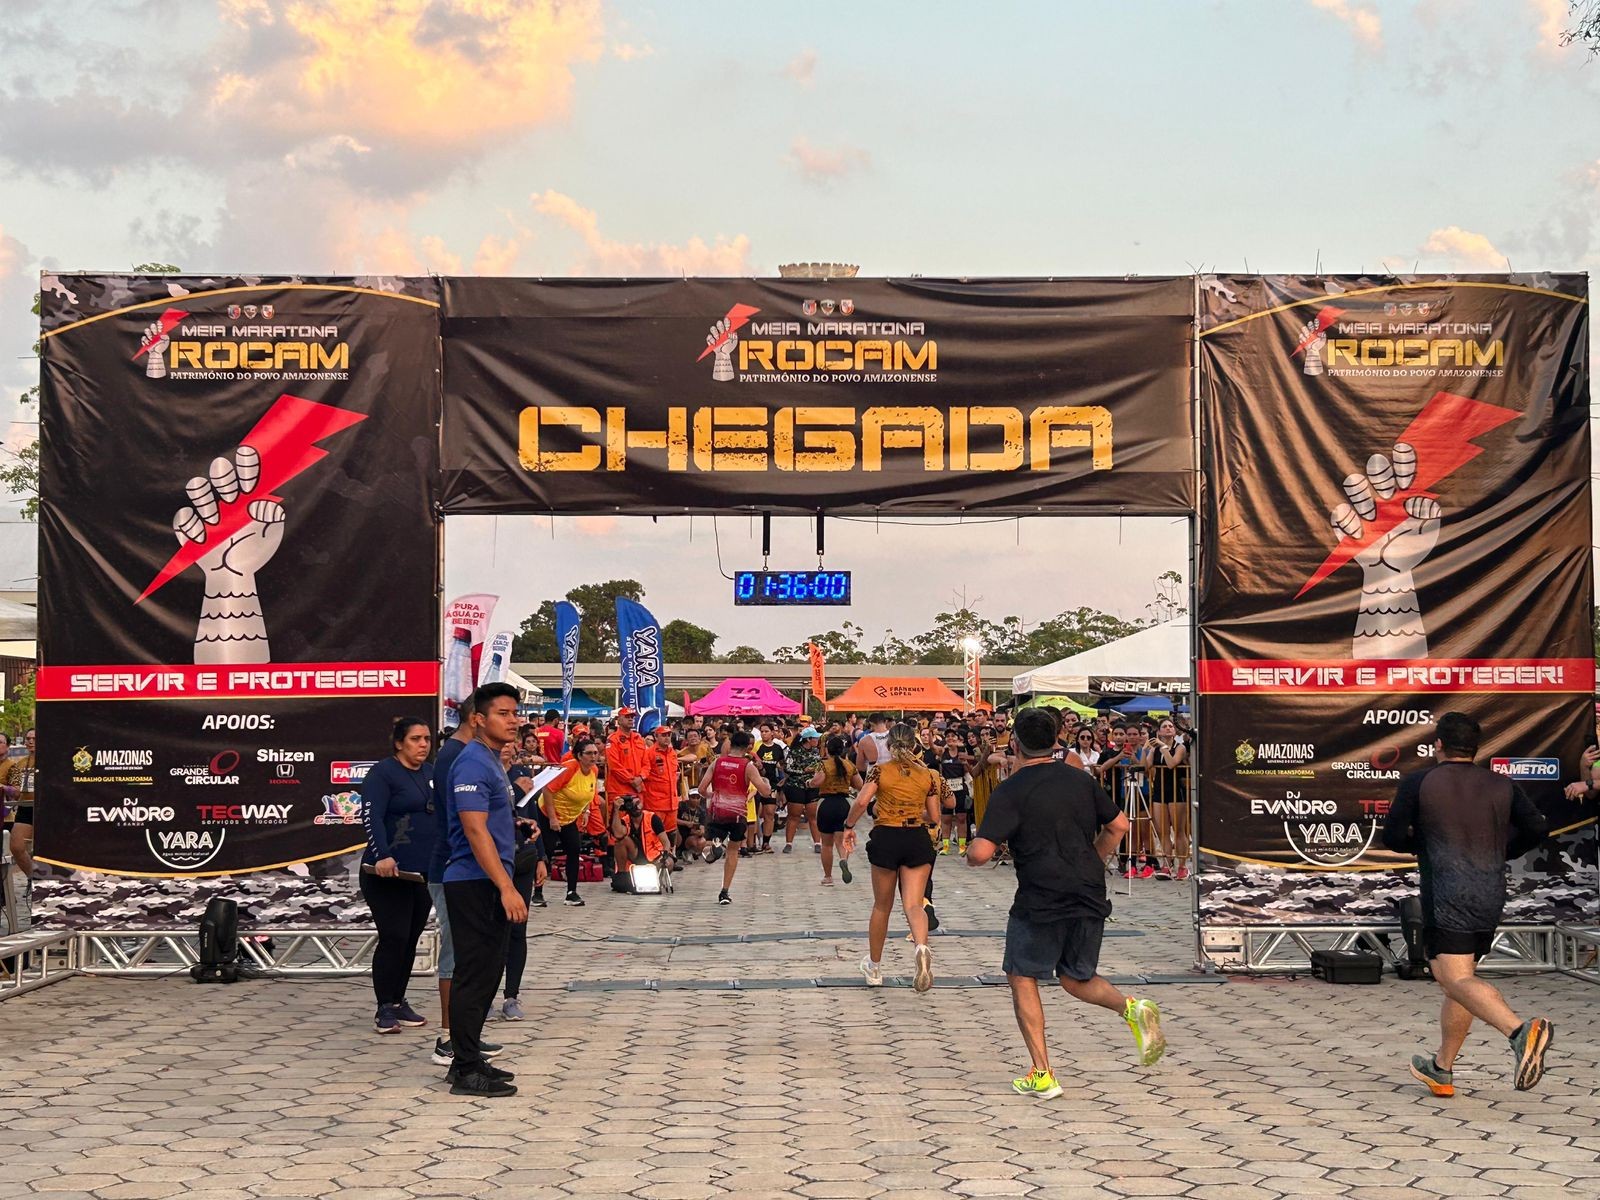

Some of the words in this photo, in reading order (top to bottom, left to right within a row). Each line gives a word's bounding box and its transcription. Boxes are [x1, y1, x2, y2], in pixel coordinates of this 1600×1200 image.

[182, 325, 226, 337] MEIA
[232, 325, 338, 338] MARATONA
[752, 322, 800, 335] MEIA
[807, 322, 925, 335] MARATONA
[1338, 322, 1382, 335] MEIA
[1388, 322, 1493, 335] MARATONA
[170, 341, 349, 369] ROCAM
[739, 340, 938, 371] ROCAM
[1327, 339, 1504, 367] ROCAM
[236, 372, 252, 381] DO
[253, 372, 281, 380] POVO
[282, 372, 349, 381] AMAZONENSE
[813, 374, 830, 383] DO
[832, 374, 862, 383] POVO
[863, 374, 937, 383] AMAZONENSE
[1392, 369, 1407, 377] DO
[1410, 369, 1436, 377] POVO
[1438, 369, 1504, 377] AMAZONENSE
[518, 405, 1114, 473] CHEGADA
[472, 611, 486, 619] DE
[634, 627, 660, 688] YARA
[70, 672, 185, 692] SERVIR
[196, 672, 218, 691] E
[228, 669, 407, 690] PROTEGER!
[1232, 667, 1344, 686] SERVIR
[1356, 667, 1376, 685] E
[1387, 666, 1564, 685] PROTEGER!
[1100, 681, 1190, 692] MEDALHAS
[201, 714, 275, 730] APOIOS:
[1362, 709, 1434, 725] APOIOS:
[256, 749, 315, 762] Shizen
[1257, 743, 1314, 759] AMAZONAS
[95, 750, 153, 766] AMAZONAS
[170, 767, 209, 776] GRANDE
[1331, 762, 1369, 770] GRANDE
[1493, 763, 1557, 775] FAMETRO
[333, 767, 371, 779] FAME
[1347, 770, 1400, 779] CIRCULAR
[185, 775, 239, 785] CIRCULAR
[1286, 790, 1300, 799] DJ
[123, 798, 138, 806] DJ
[1250, 799, 1338, 814] EVANDRO
[86, 806, 175, 822] EVANDRO
[196, 804, 293, 819] TECWAY
[1299, 822, 1363, 843] YARA
[158, 831, 214, 849] YARA
